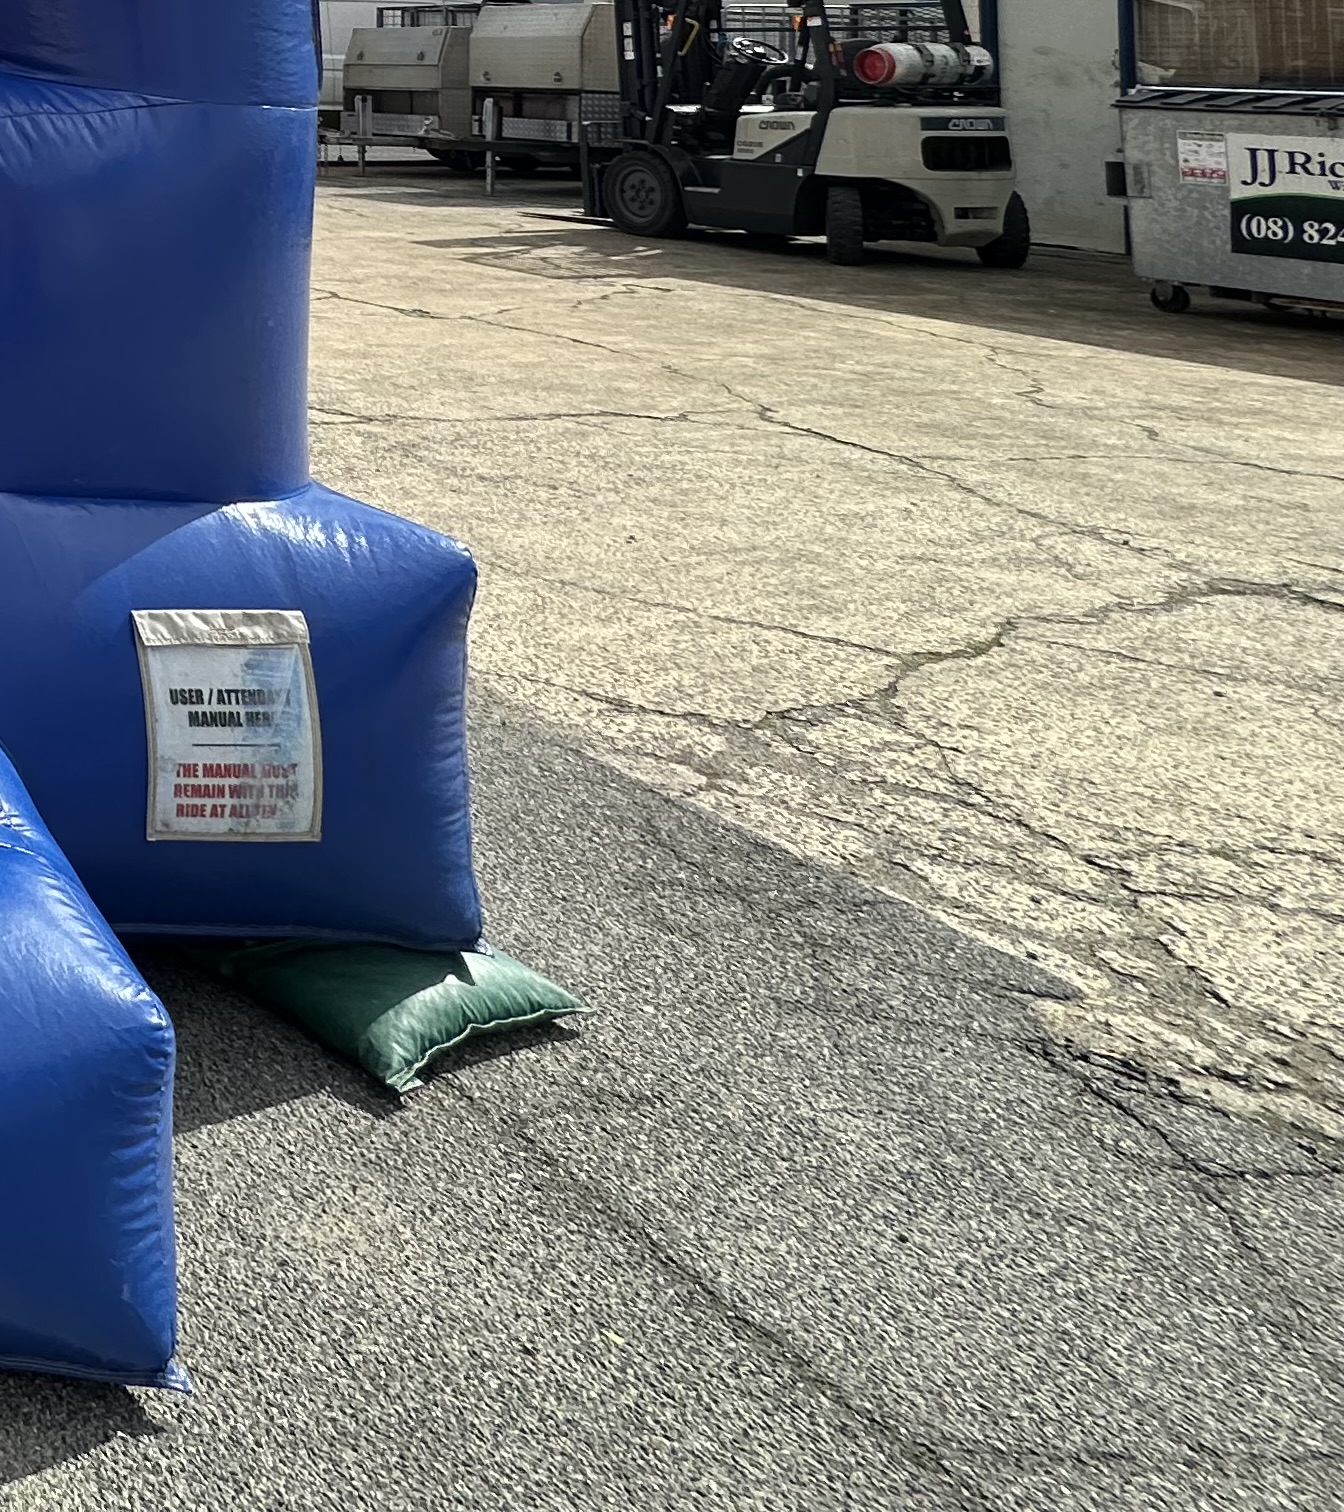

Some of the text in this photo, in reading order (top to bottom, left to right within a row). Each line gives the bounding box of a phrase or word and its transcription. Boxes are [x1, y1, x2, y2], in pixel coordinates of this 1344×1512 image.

[1240, 214, 1294, 243] (08)
[169, 688, 291, 706] USER / ATTENDA
[188, 711, 275, 727] MANUAL HER
[176, 763, 199, 778] THE
[202, 763, 257, 778] MANUAL
[174, 784, 225, 798] REMAIN
[176, 804, 207, 818] RIDE
[209, 804, 227, 818] AT
